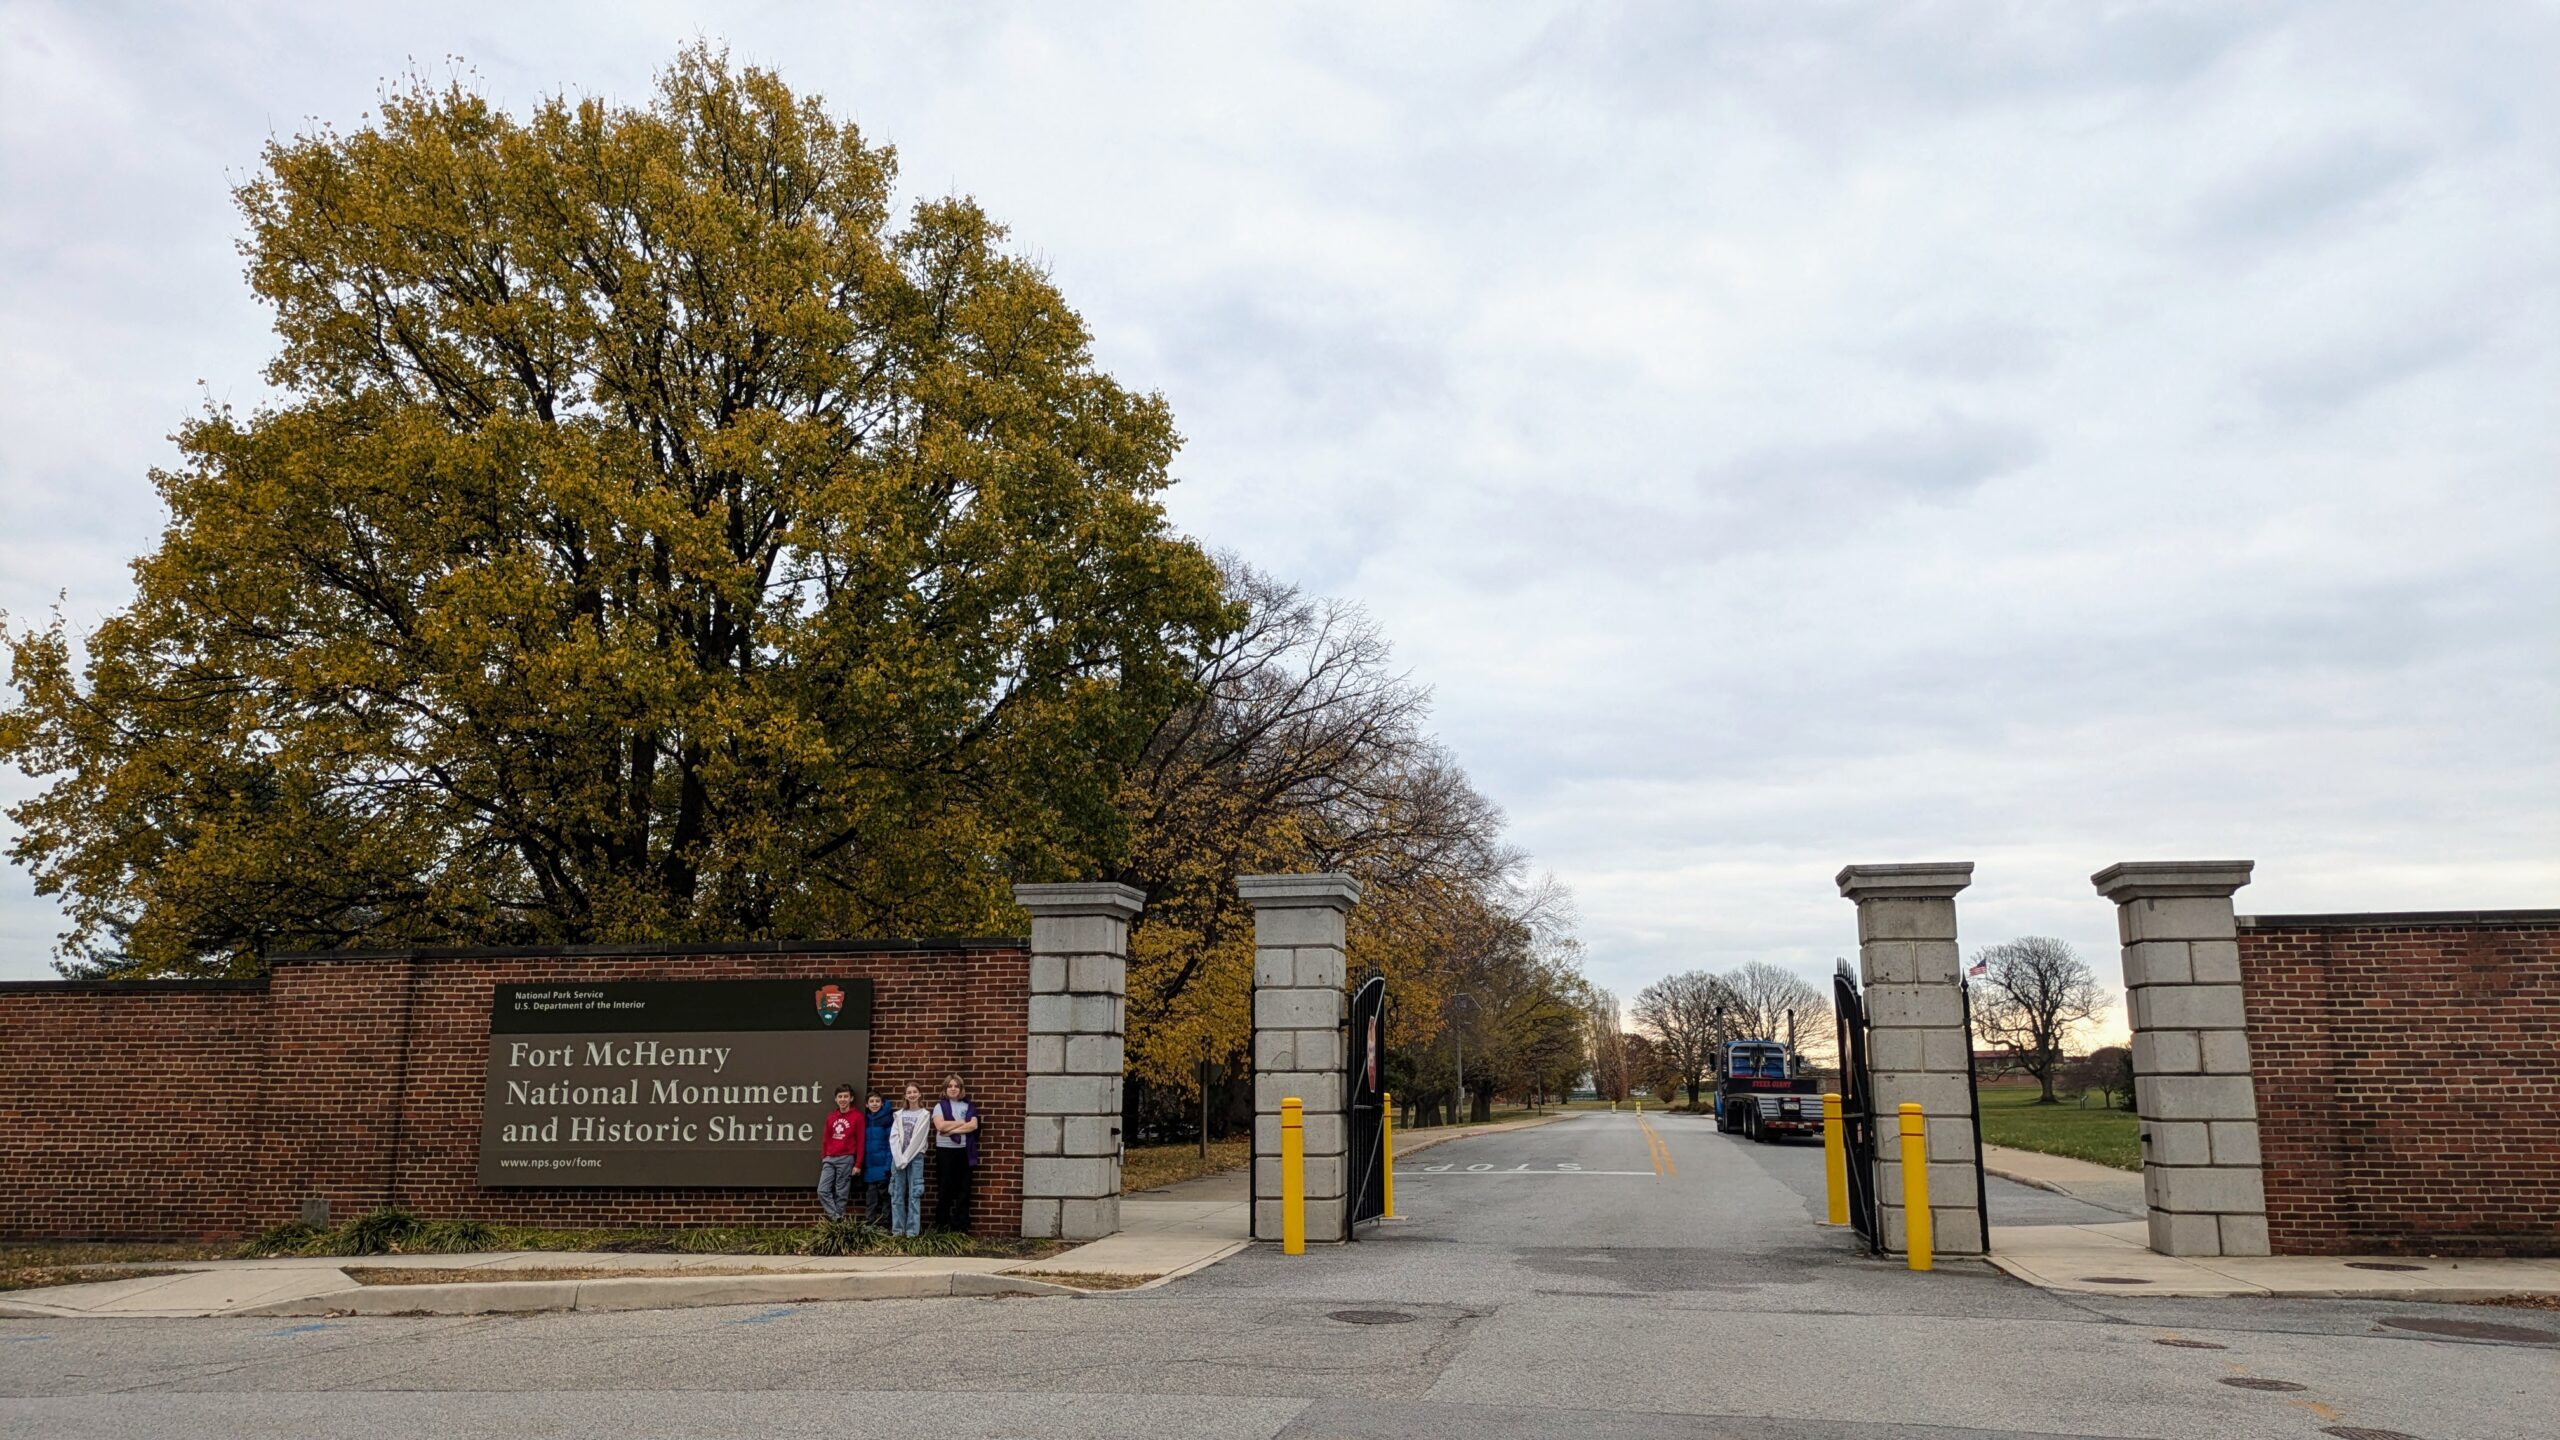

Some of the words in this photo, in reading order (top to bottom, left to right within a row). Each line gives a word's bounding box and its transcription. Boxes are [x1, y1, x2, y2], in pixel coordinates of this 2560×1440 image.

[515, 991, 551, 1000] National
[553, 991, 571, 999] Park
[573, 990, 604, 999] Service
[514, 1002, 531, 1010] U.S.
[533, 1002, 583, 1011] Department
[585, 1001, 595, 1010] of
[597, 1001, 611, 1009] the
[613, 1001, 646, 1009] Interior
[509, 1042, 574, 1067] Fort
[583, 1041, 732, 1073] McHenry
[505, 1079, 638, 1105] National
[649, 1079, 823, 1104] Monument
[502, 1116, 558, 1143] and
[569, 1116, 698, 1142] Historic
[708, 1115, 814, 1142] Shrine
[500, 1157, 602, 1170] www.nps.gov/fomc
